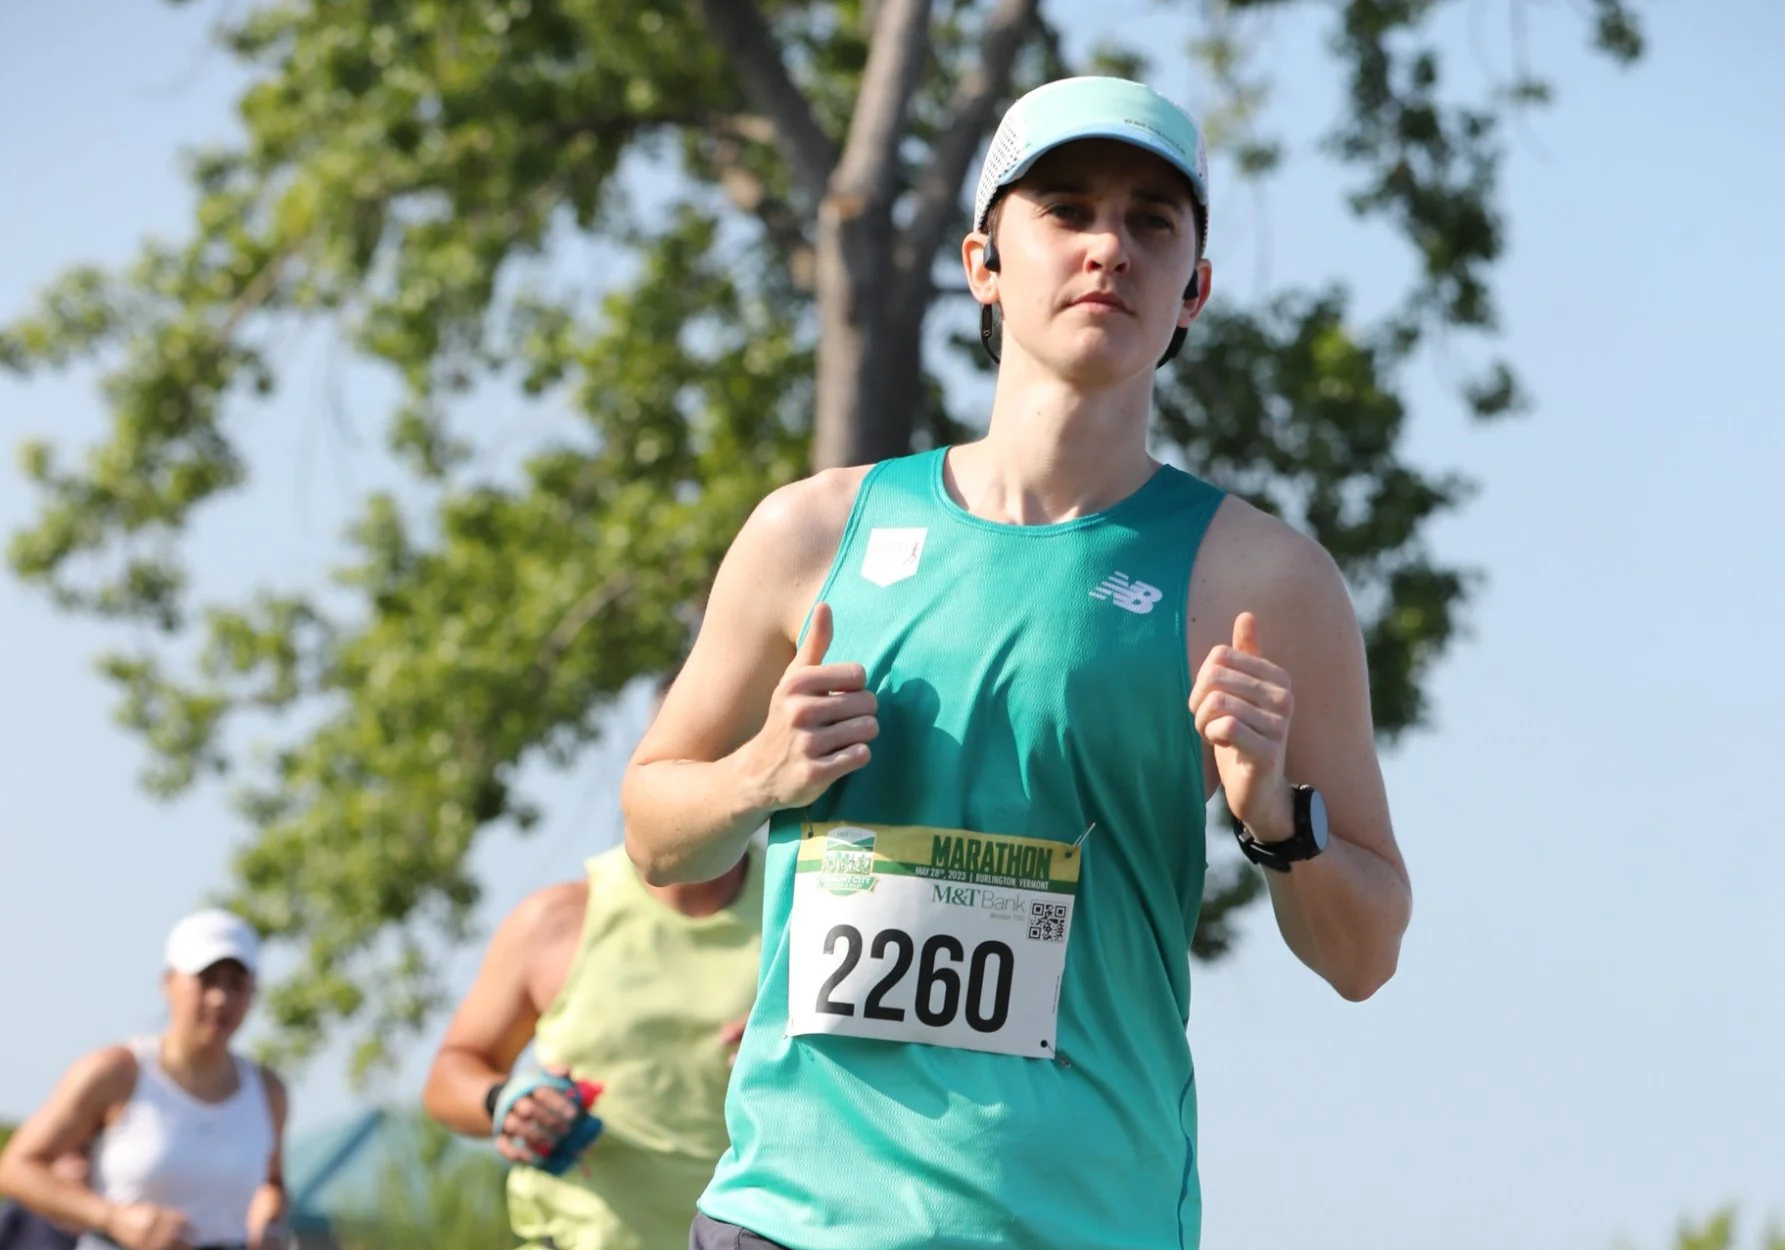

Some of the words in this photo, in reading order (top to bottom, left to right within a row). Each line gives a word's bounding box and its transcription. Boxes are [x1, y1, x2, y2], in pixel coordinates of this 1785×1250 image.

[931, 835, 1053, 879] MARATHON
[915, 866, 930, 877] MAY
[948, 871, 966, 881] 2023
[1019, 880, 1049, 891] VERMONT
[932, 885, 981, 907] M&T
[981, 890, 1025, 913] Bank
[815, 923, 1015, 1033] 2260
